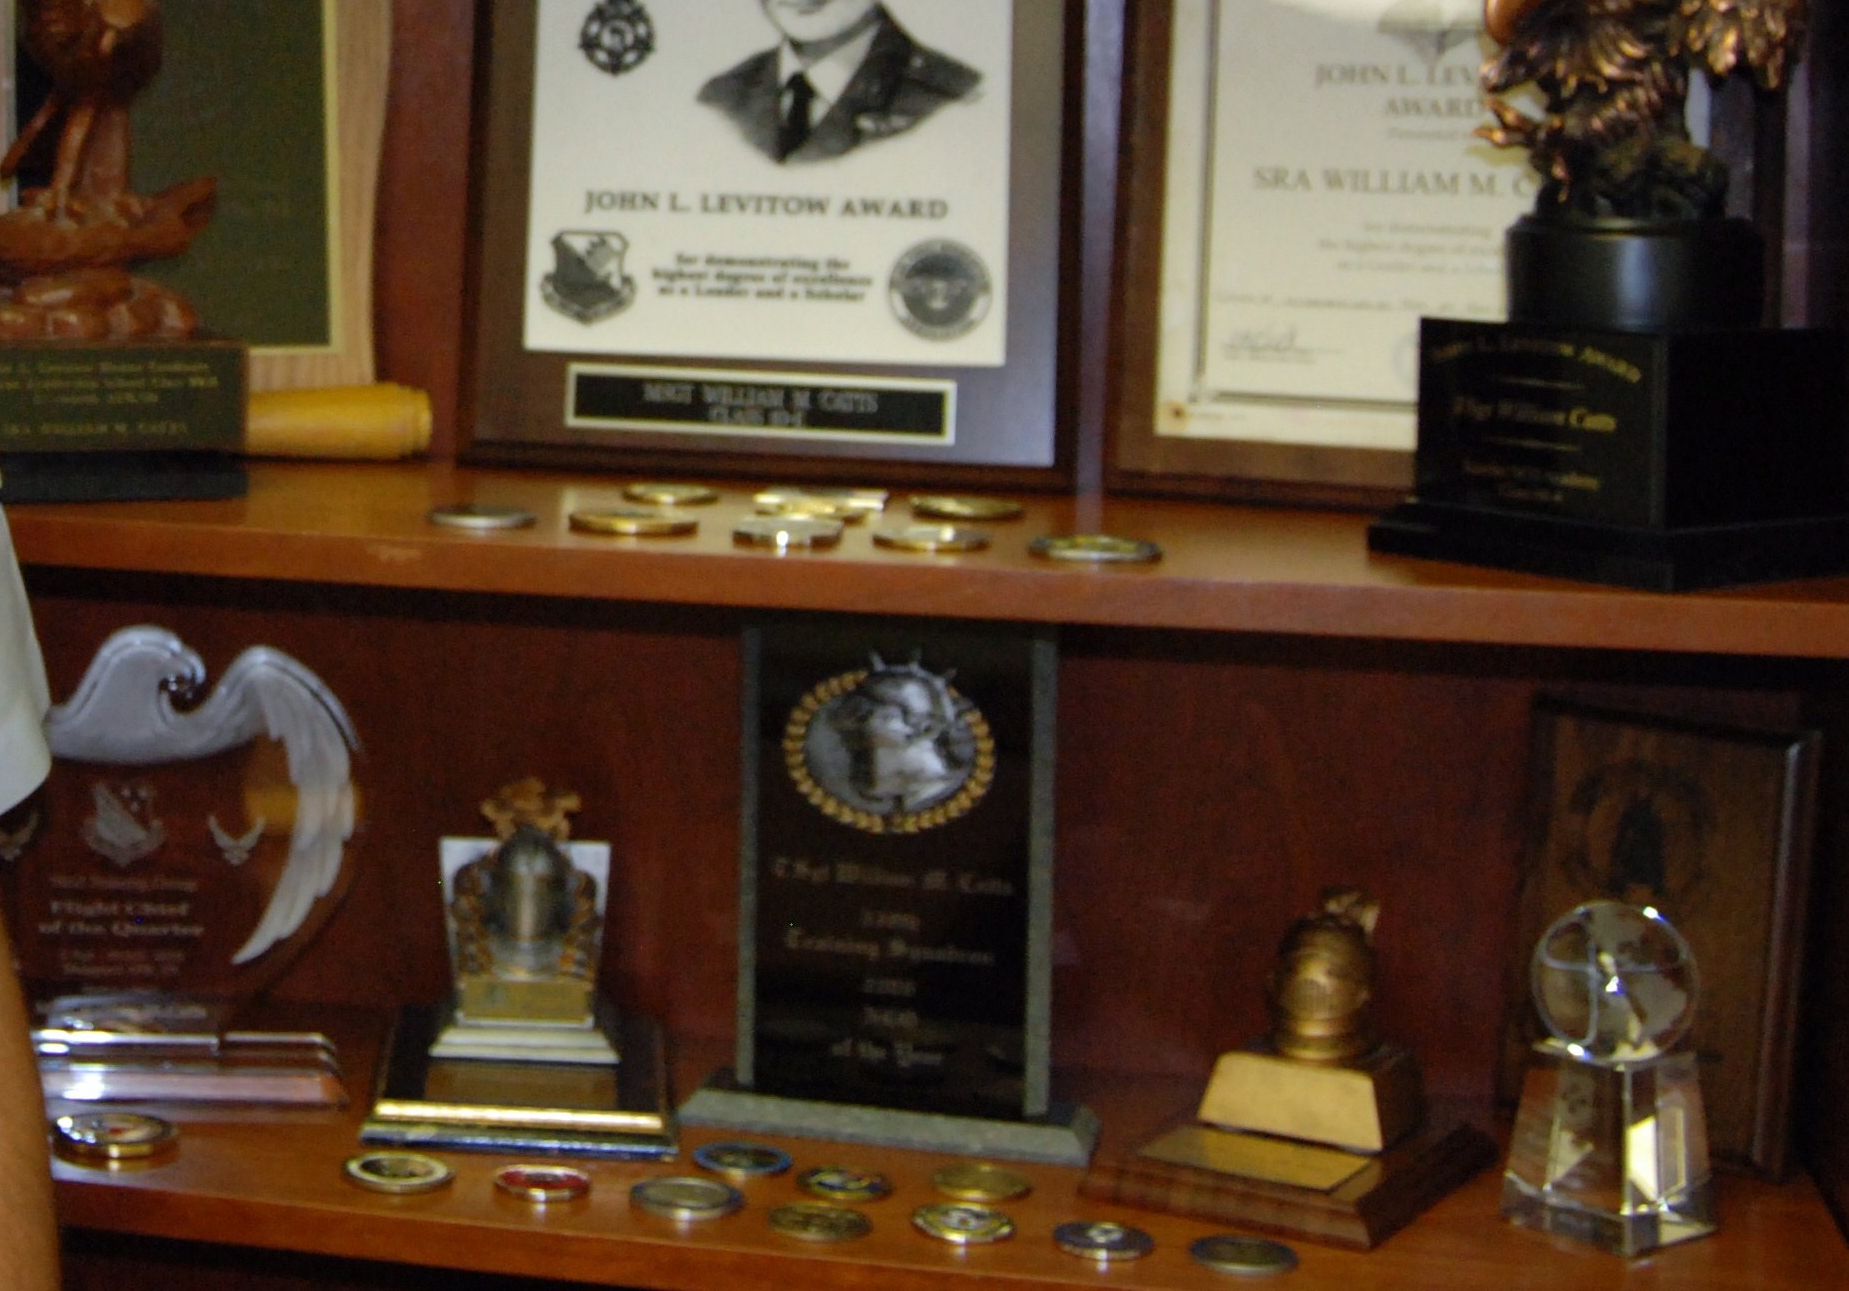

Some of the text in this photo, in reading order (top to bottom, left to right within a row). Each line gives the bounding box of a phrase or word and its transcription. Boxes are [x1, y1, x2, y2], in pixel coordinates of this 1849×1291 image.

[1314, 63, 1389, 89] JOHN
[1255, 165, 1312, 191] SRA
[1321, 168, 1460, 196] WILLIAM
[585, 189, 950, 220] JOHN L. LEVITOW AWARD
[819, 391, 879, 413] CATTS
